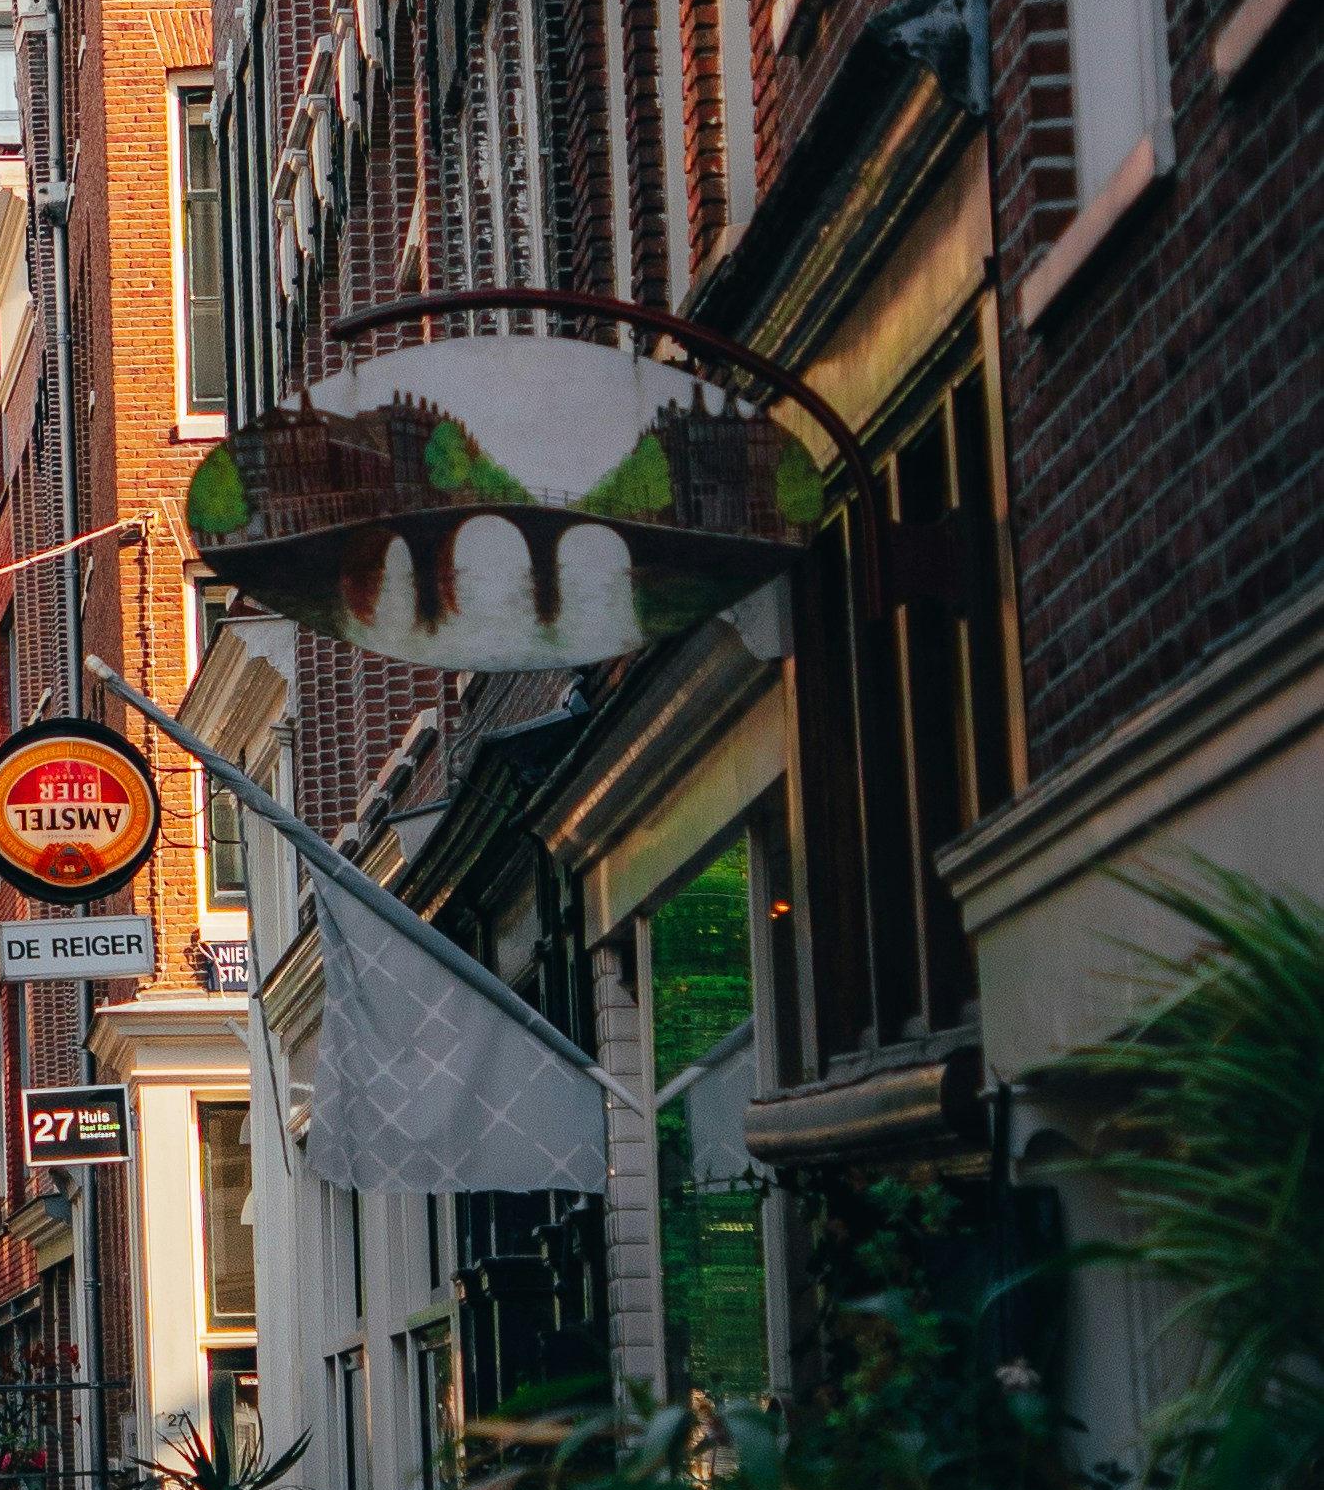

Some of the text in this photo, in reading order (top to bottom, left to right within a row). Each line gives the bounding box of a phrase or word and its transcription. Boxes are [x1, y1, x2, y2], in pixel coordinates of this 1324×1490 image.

[39, 782, 96, 800] BIER
[14, 808, 122, 832] AMSTEL
[7, 934, 143, 961] DE REIGER
[33, 1112, 74, 1142] 27
